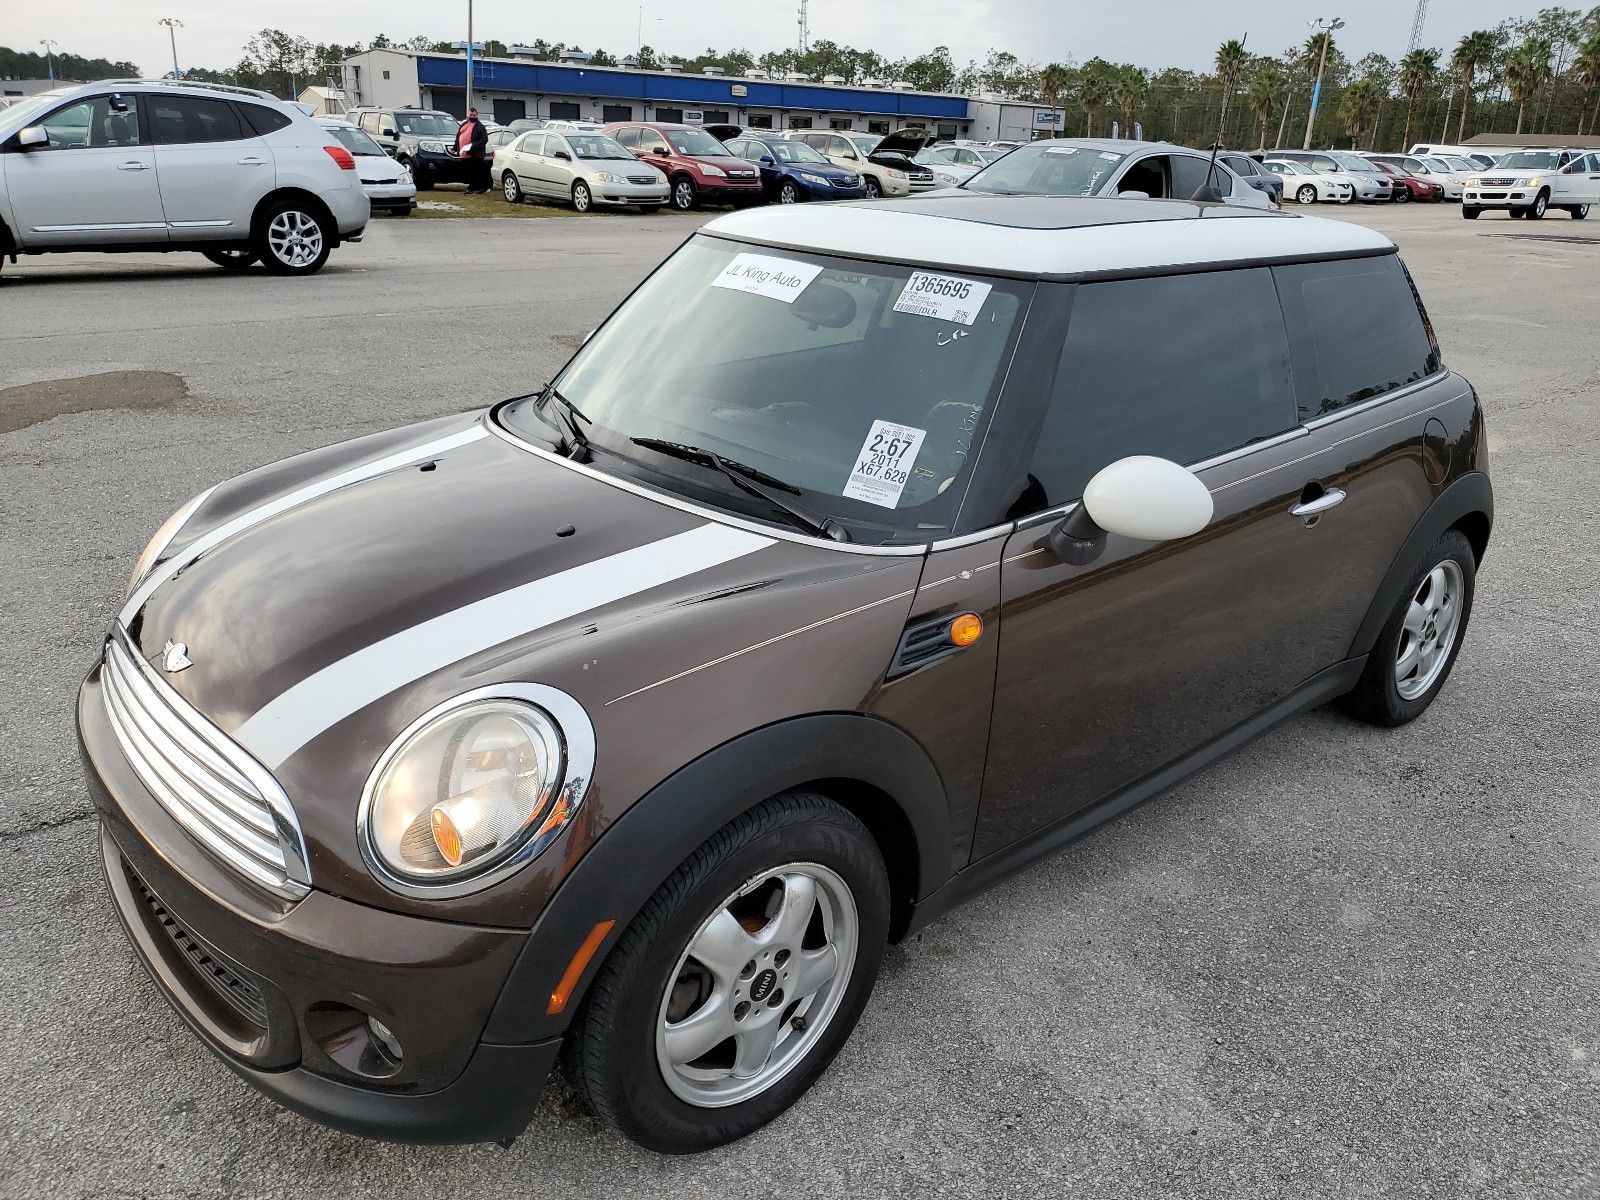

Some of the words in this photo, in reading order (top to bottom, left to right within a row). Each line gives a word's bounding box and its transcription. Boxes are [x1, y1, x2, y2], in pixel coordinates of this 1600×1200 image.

[726, 264, 741, 276] JL
[742, 265, 771, 284] King
[769, 271, 802, 288] Auto
[909, 275, 973, 300] 1365695
[868, 433, 913, 459] 2:67
[857, 461, 907, 484] X67,628
[870, 453, 900, 469] 2011
[755, 973, 773, 998] MINI
